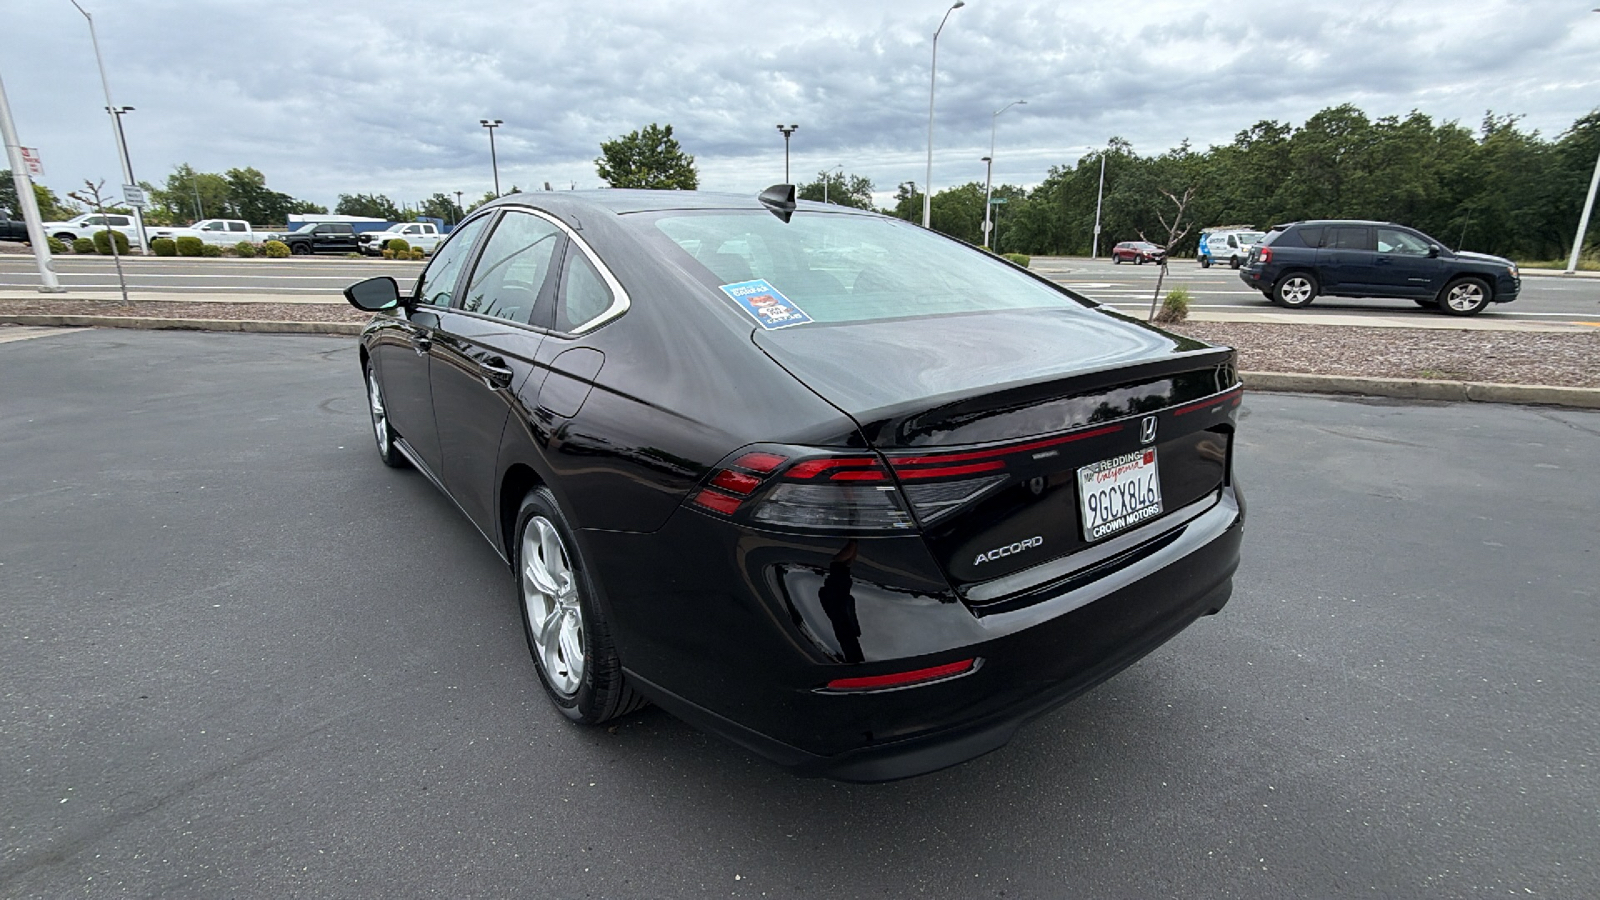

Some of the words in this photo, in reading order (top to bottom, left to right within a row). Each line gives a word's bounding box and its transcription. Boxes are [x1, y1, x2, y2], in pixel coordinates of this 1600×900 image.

[1096, 461, 1144, 483] California
[1100, 451, 1140, 471] REDDING
[1088, 473, 1155, 527] 9GCX846
[1093, 517, 1126, 537] CROWN
[1126, 504, 1159, 525] MOTORS
[973, 536, 1043, 566] ACCORD
